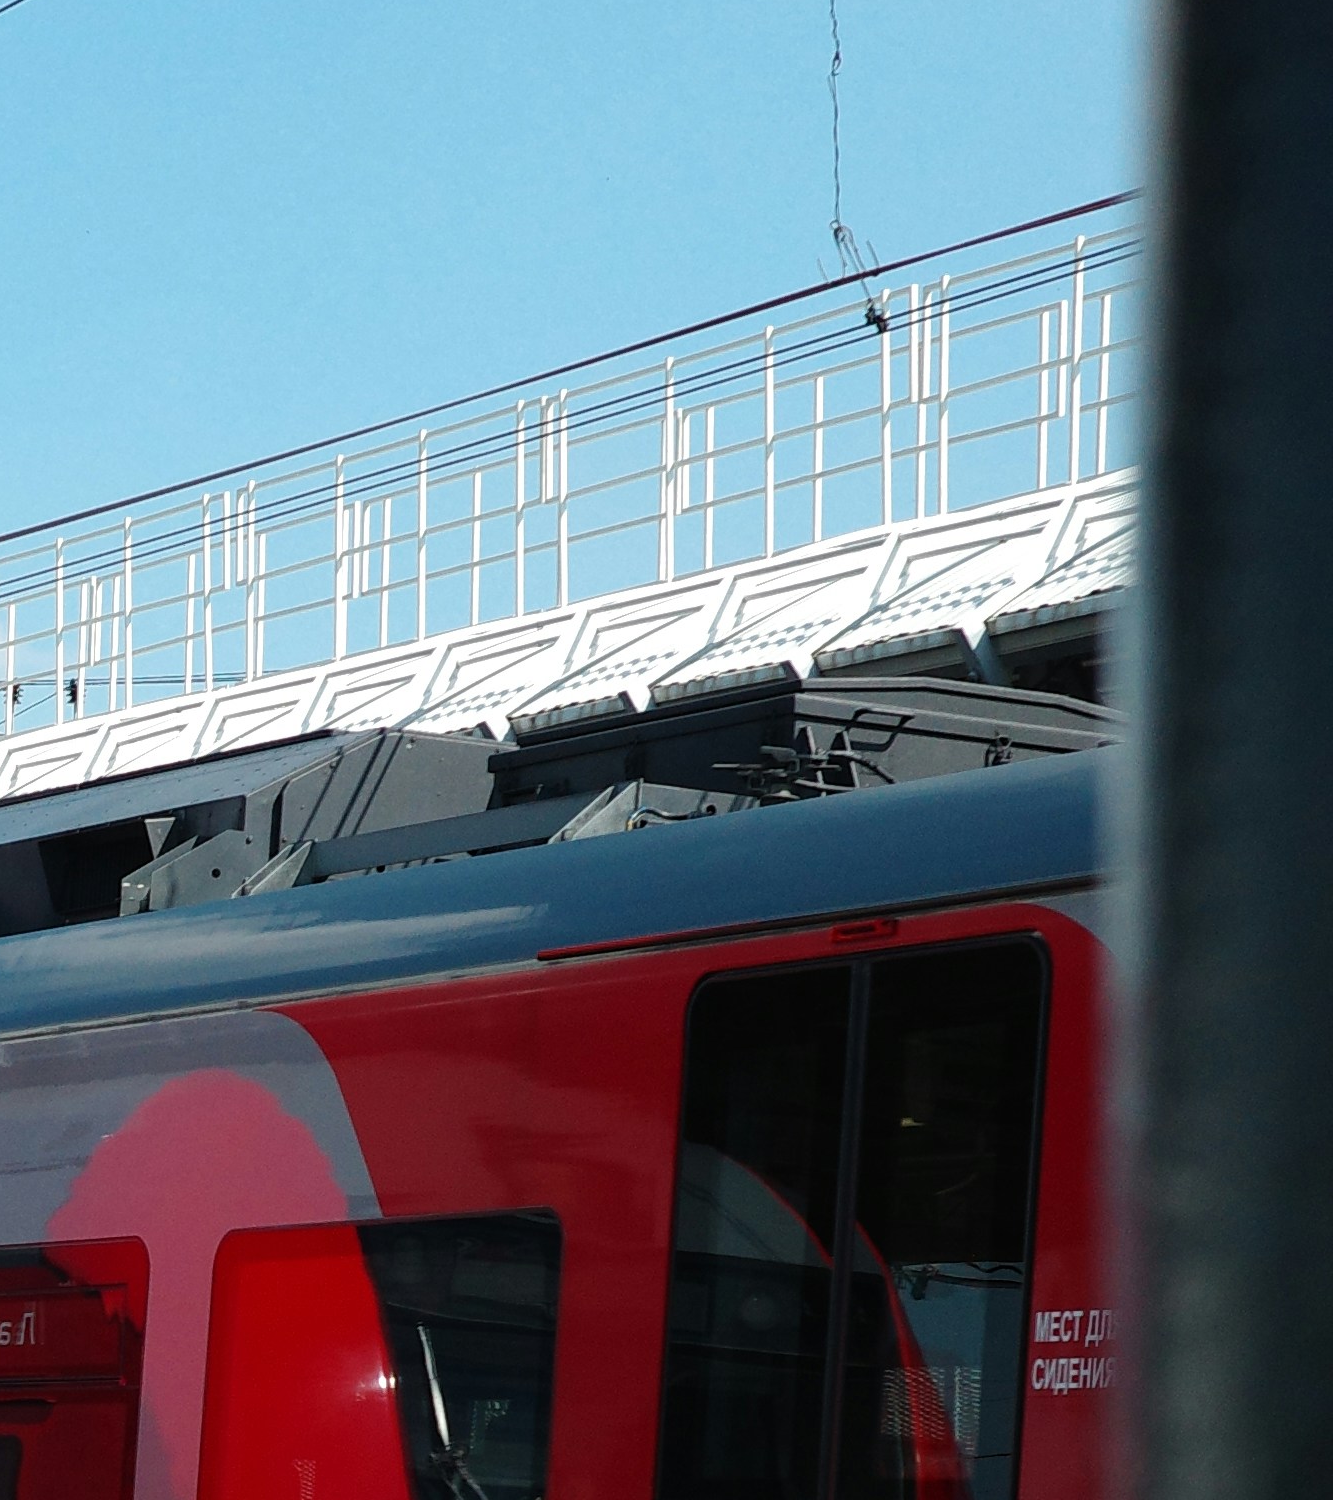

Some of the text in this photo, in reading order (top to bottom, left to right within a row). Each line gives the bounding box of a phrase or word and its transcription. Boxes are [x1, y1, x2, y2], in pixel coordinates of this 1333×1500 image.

[1034, 1309, 1113, 1347] МЕСТ ДЛ
[1032, 1357, 1117, 1395] СИДЕНИЯ
